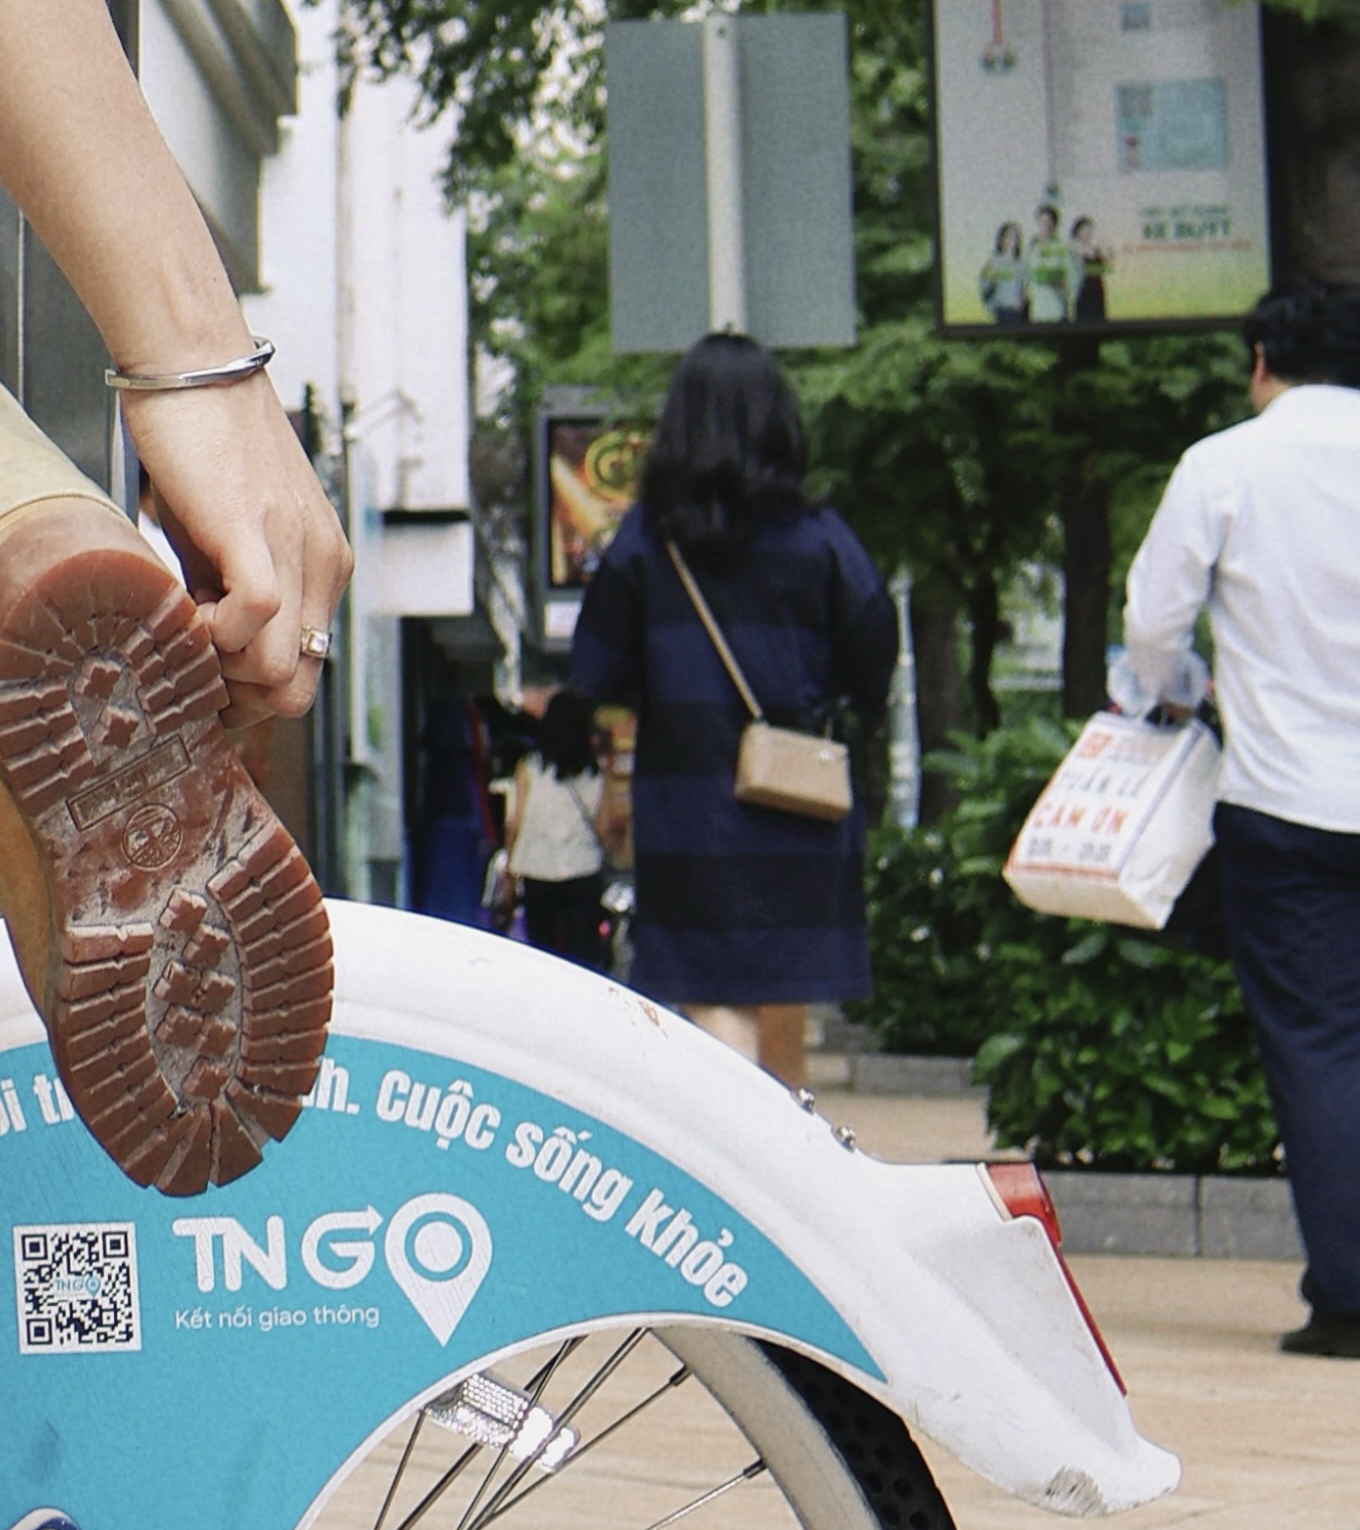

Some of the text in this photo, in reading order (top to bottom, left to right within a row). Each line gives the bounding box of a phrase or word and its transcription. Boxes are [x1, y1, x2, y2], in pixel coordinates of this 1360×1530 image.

[376, 1069, 502, 1151] Cuộc
[505, 1120, 634, 1223] sống
[624, 1187, 749, 1308] khỏe
[175, 1303, 380, 1332] Kết nối giao thông
